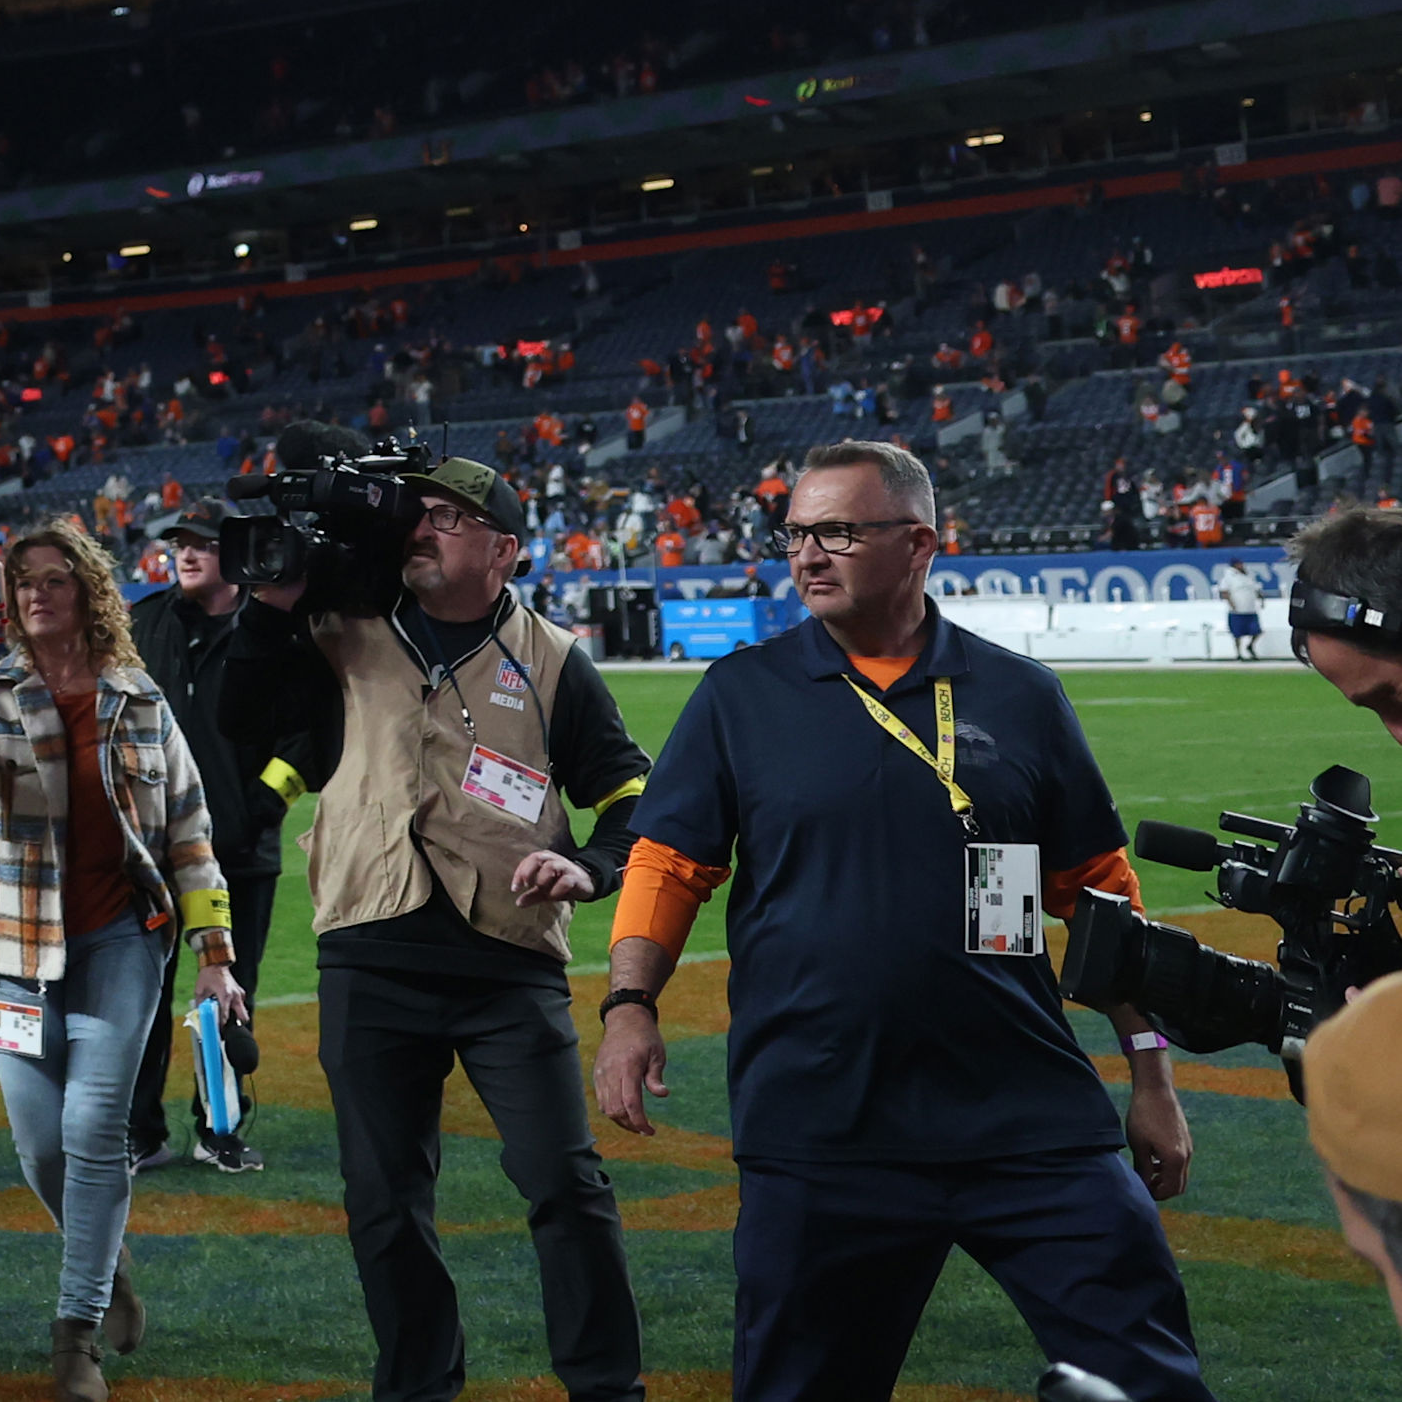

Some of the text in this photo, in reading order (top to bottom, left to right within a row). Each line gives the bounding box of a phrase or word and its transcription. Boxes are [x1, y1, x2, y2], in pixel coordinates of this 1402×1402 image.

[499, 669, 525, 690] NFL
[488, 691, 525, 712] MEDIA
[940, 688, 951, 723] BENCH
[1287, 1001, 1313, 1015] Canon
